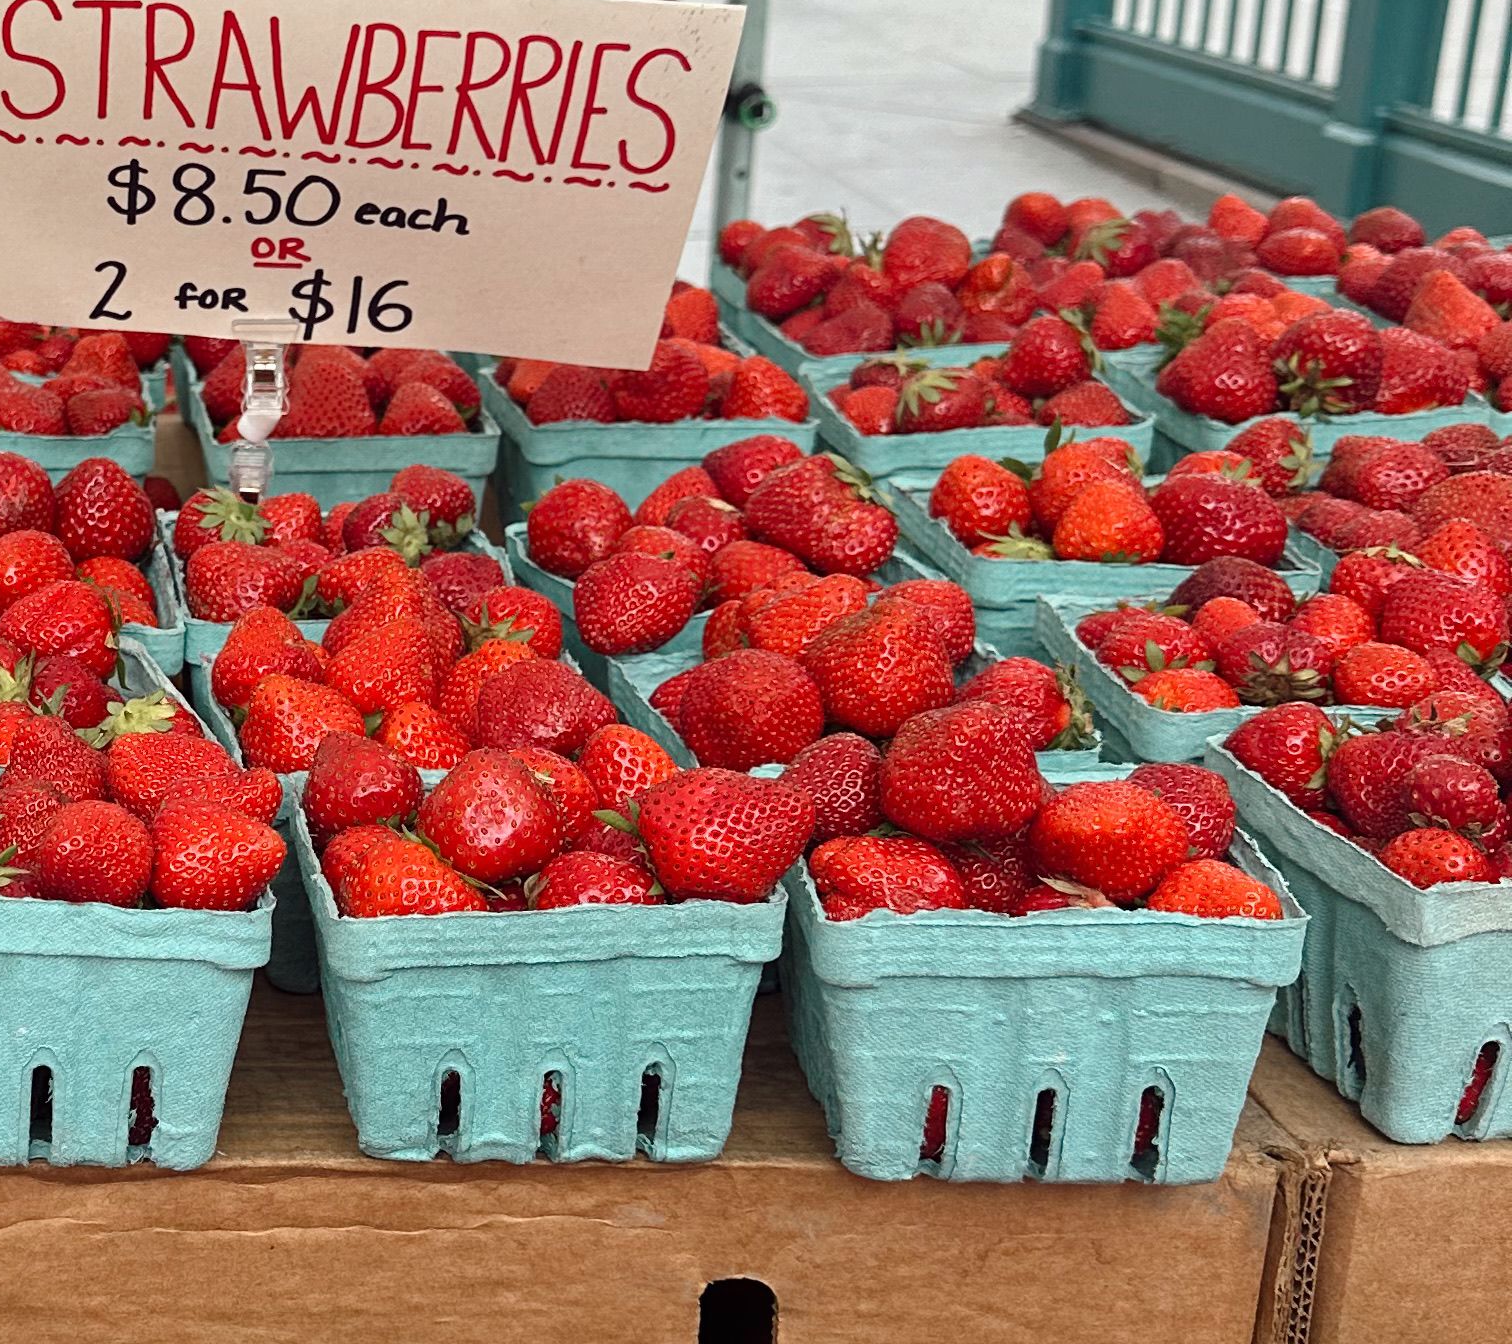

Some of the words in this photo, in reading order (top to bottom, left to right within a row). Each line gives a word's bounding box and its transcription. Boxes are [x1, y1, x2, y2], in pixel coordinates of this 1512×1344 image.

[106, 158, 341, 227] $8.50
[353, 197, 470, 236] each
[250, 236, 312, 263] OR
[88, 260, 133, 321] 2
[288, 268, 413, 341] $16
